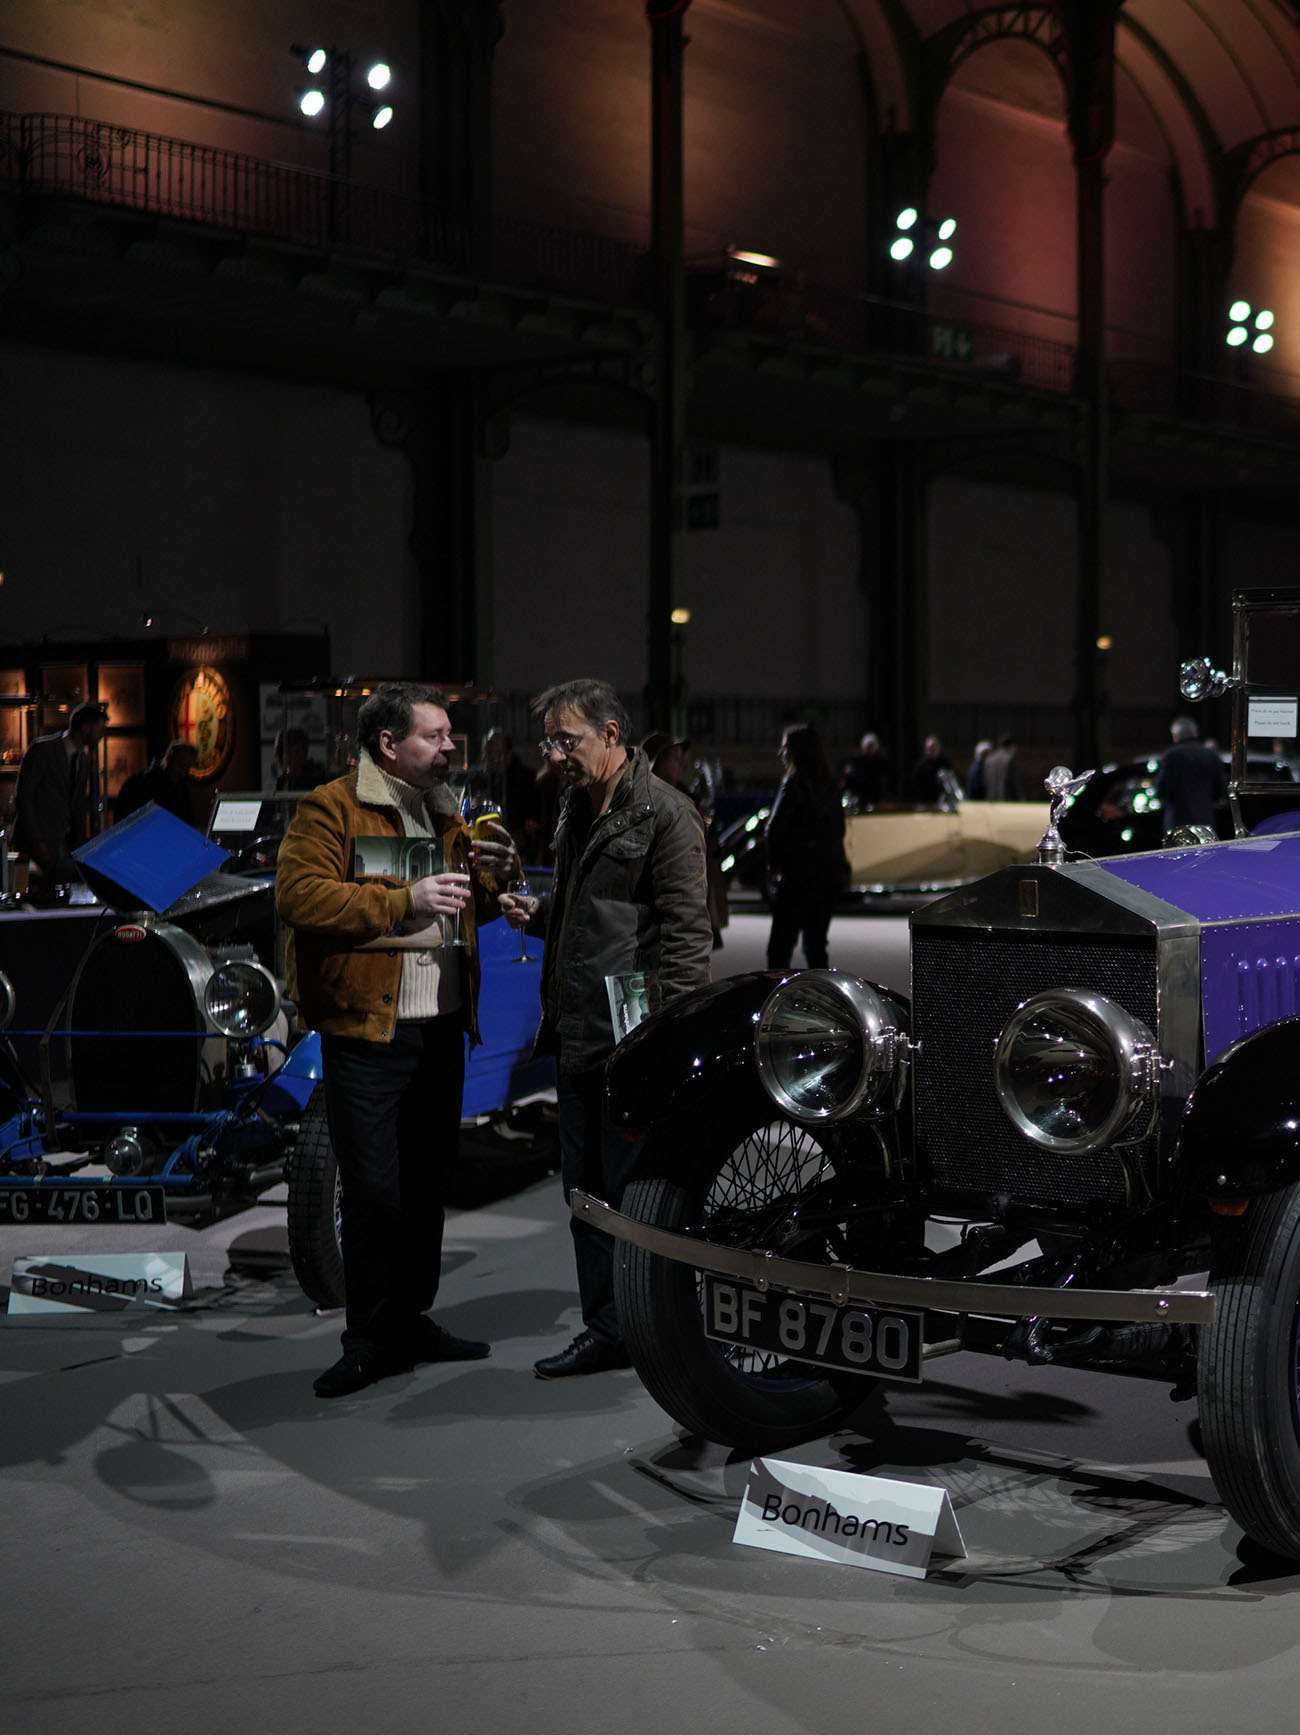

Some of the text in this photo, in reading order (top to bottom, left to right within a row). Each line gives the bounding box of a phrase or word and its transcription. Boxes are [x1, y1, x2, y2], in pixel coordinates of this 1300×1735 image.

[31, 1275, 163, 1297] Bonhams
[712, 1281, 910, 1370] BF 8780
[761, 1493, 910, 1546] Bonhams
